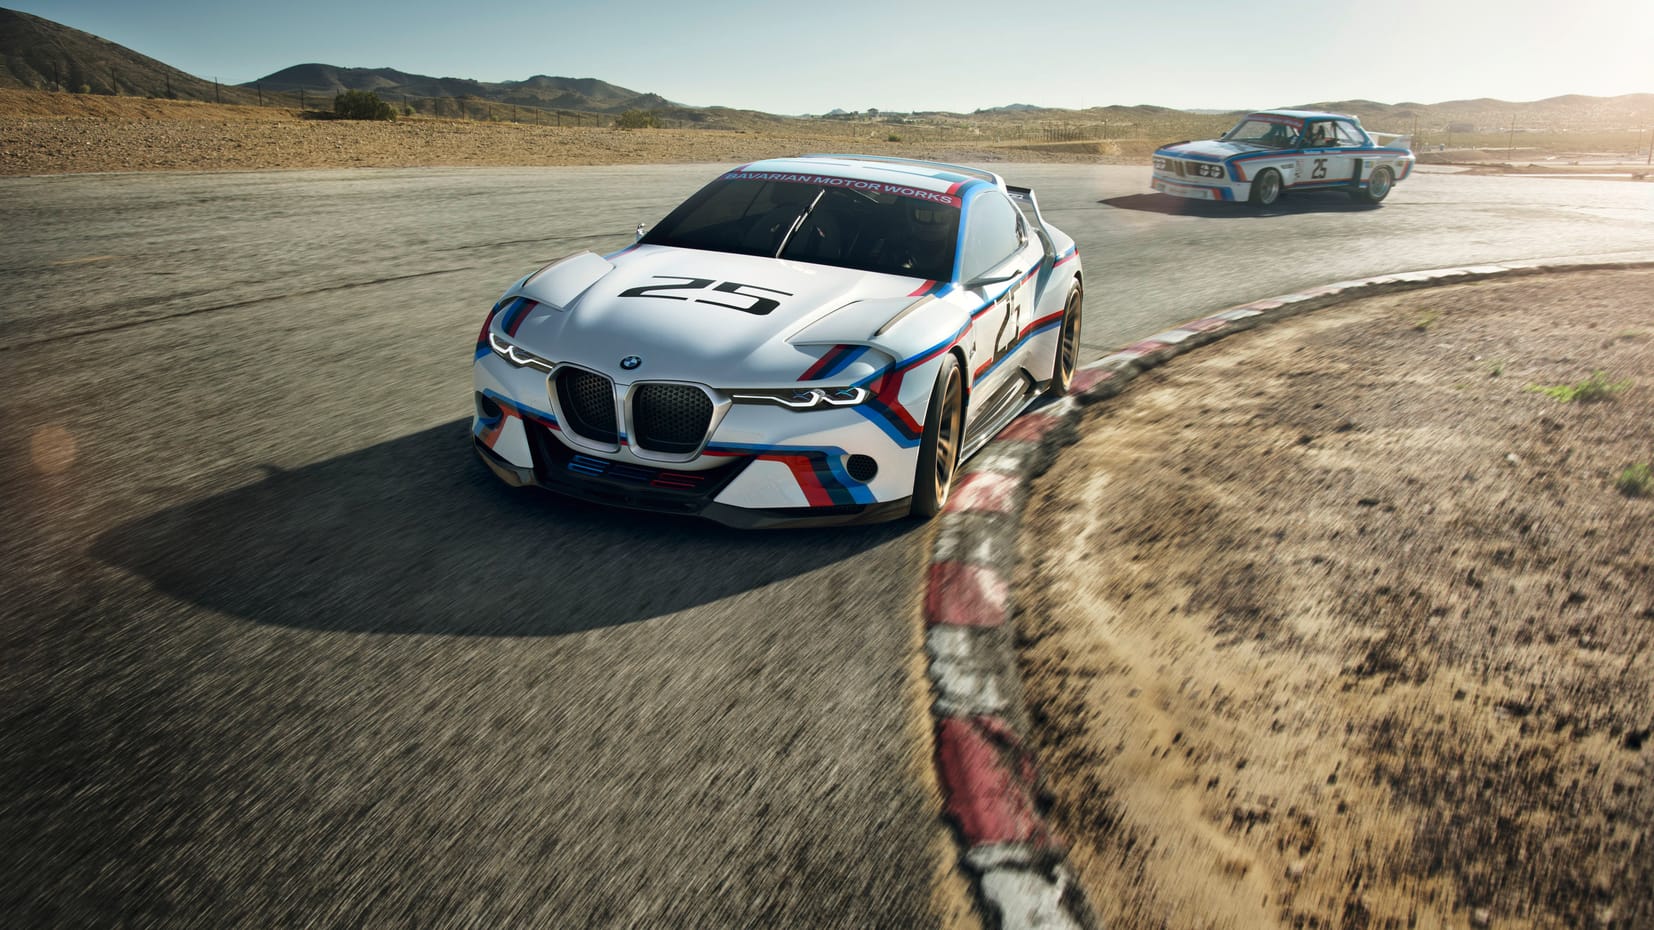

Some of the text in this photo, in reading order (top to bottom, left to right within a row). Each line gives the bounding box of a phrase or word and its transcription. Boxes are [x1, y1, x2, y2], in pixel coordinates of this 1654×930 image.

[1312, 158, 1329, 179] 25
[725, 172, 953, 204] BAVARIAN MOTOR WORKS
[617, 275, 794, 316] 25
